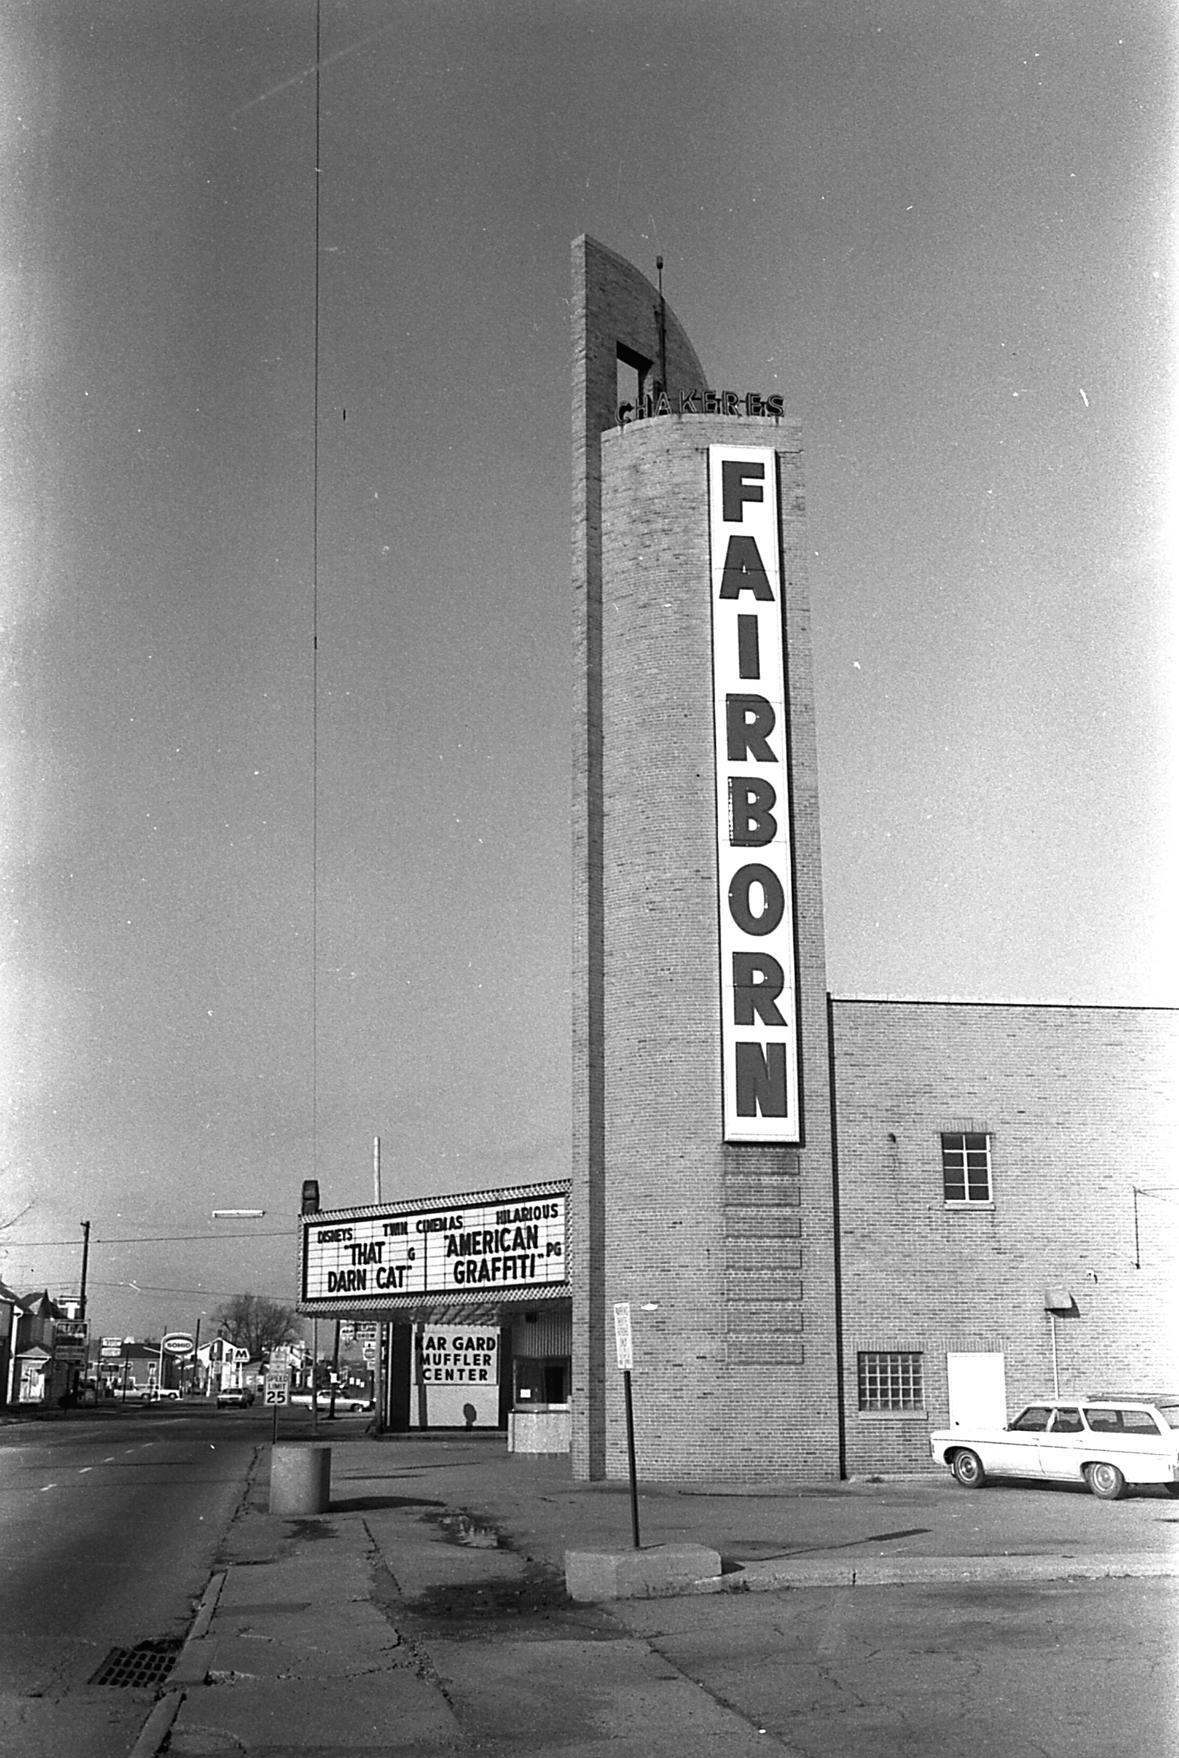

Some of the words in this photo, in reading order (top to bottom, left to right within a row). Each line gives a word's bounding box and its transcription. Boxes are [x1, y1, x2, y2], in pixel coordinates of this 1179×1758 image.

[615, 390, 785, 425] CHAKERES
[719, 460, 788, 1118] FAIRBORN
[496, 1203, 559, 1225] HILARIOUS
[382, 1221, 408, 1237] TWIN
[415, 1215, 463, 1233] CINEMAS
[407, 1247, 416, 1261] G
[546, 1241, 562, 1257] PG
[327, 1268, 367, 1293] DARN
[415, 1336, 447, 1351] KAR
[452, 1336, 496, 1351] GARD
[420, 1353, 492, 1366] MUFFLER
[422, 1368, 488, 1381] CENTER
[267, 1391, 286, 1404] 25
